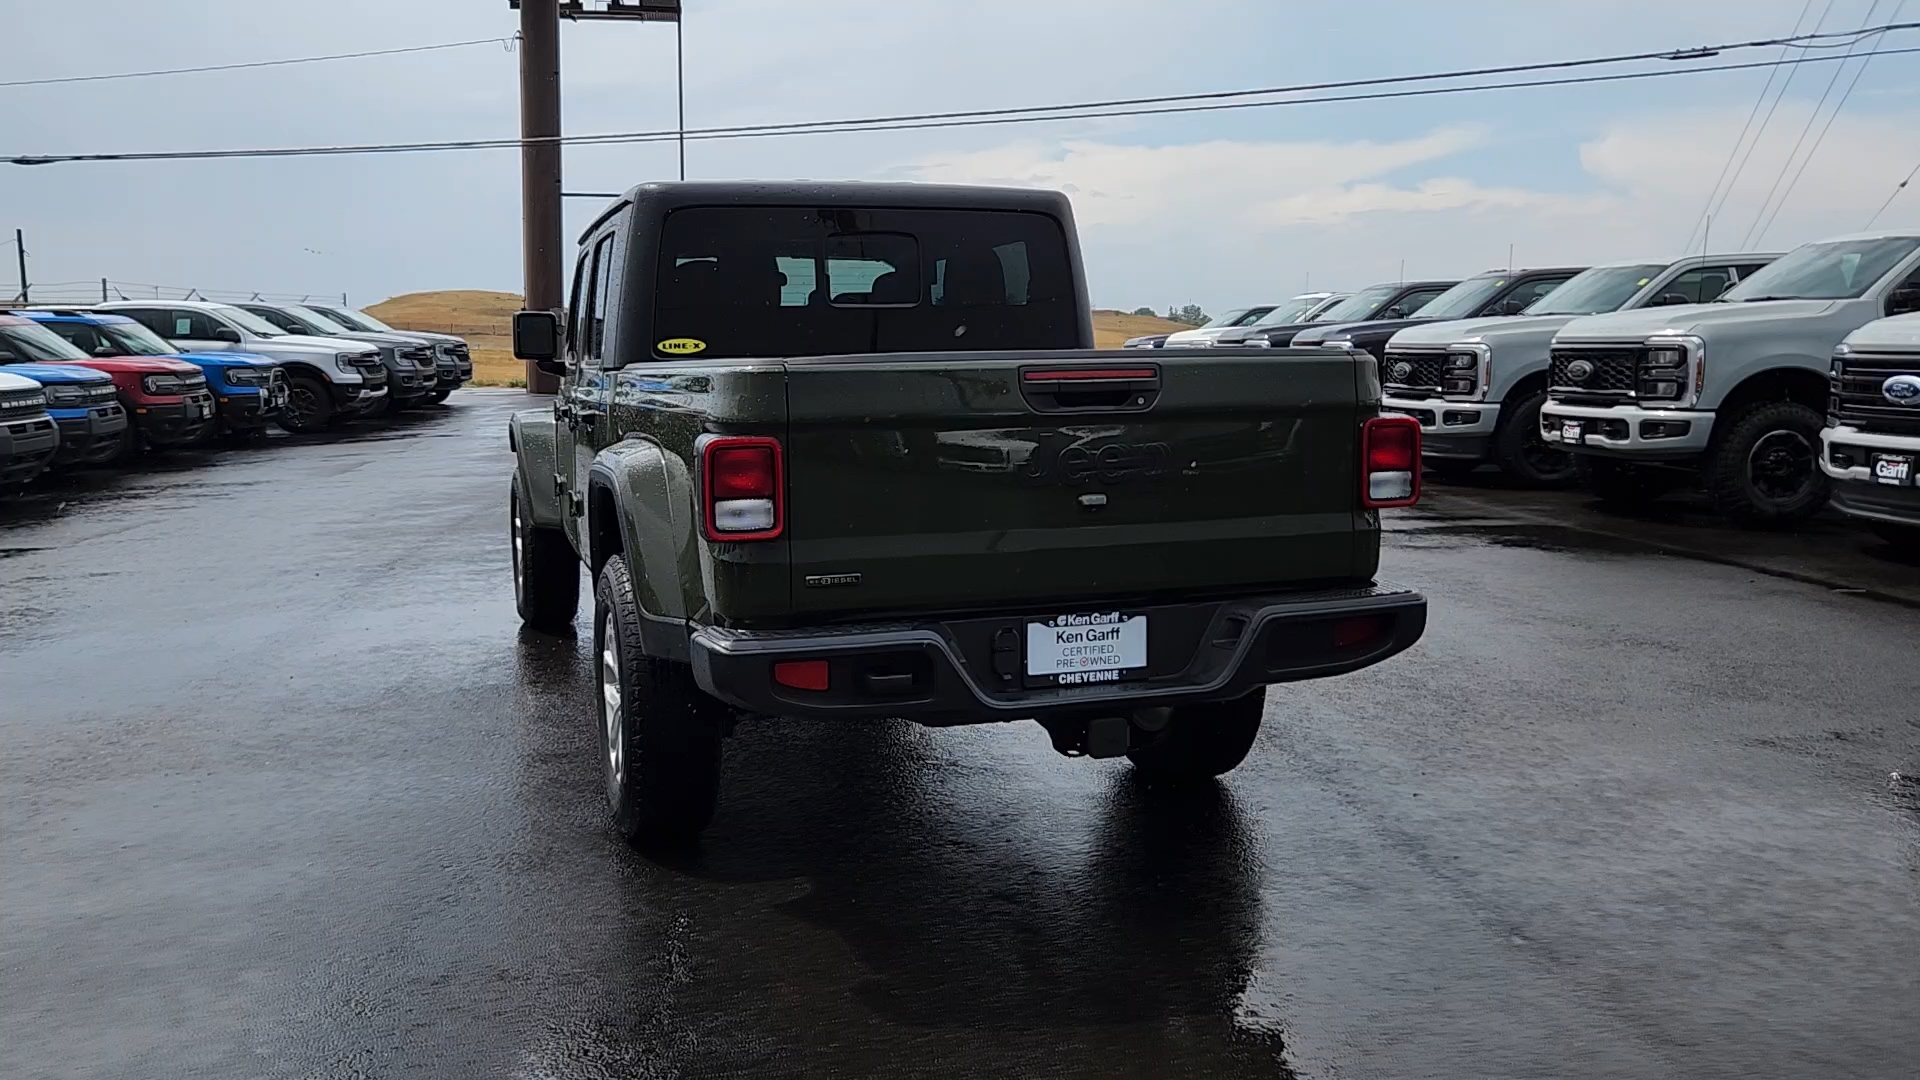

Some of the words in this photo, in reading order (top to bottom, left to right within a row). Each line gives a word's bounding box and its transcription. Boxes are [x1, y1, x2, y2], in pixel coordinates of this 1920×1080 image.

[1876, 460, 1909, 479] Garff
[1067, 614, 1090, 626] Ken
[1091, 611, 1120, 625] Garff
[1056, 630, 1083, 644] Ken
[1086, 627, 1120, 642] Garff
[1062, 644, 1115, 657] CERTIFIED
[1058, 670, 1120, 684] CHEYENNE
